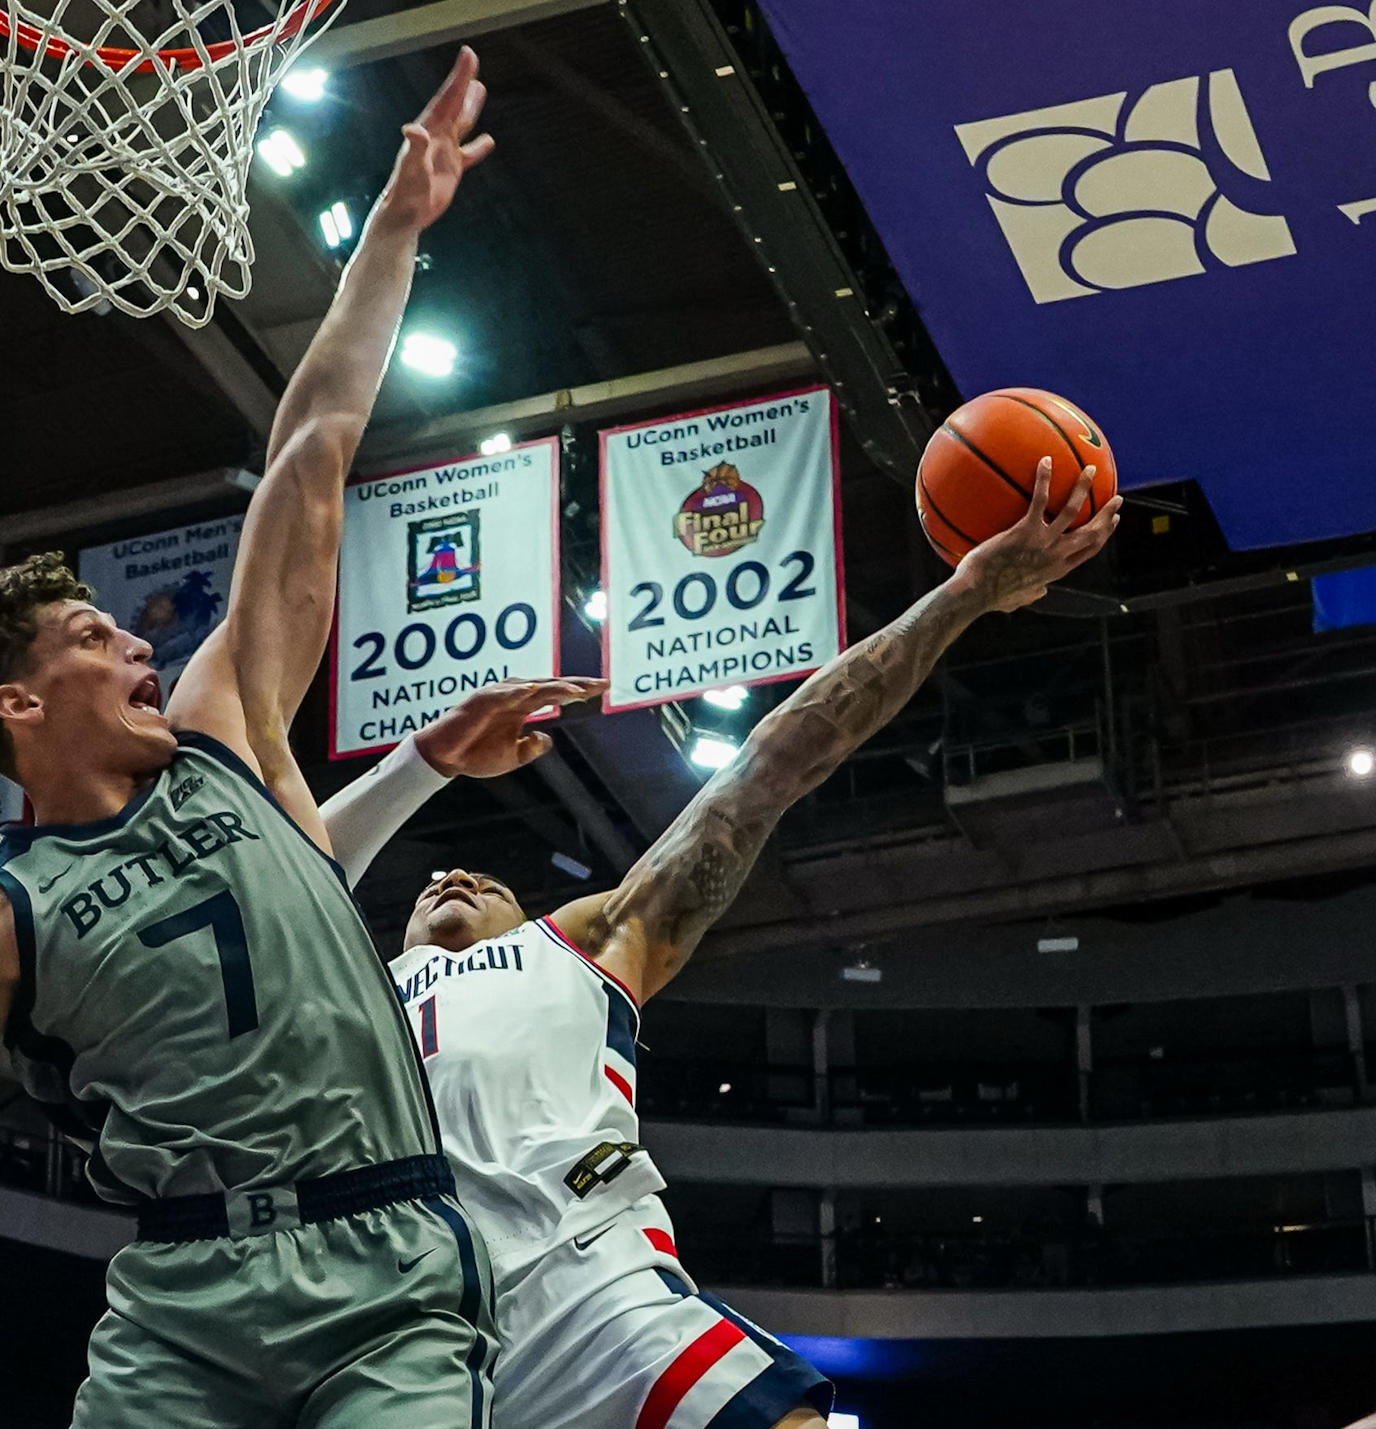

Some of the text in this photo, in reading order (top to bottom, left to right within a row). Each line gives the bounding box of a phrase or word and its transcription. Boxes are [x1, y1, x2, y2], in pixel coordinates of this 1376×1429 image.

[627, 400, 810, 450] UConn Women's
[660, 429, 776, 467] Basketball
[357, 454, 533, 502] UConn Women's
[389, 482, 499, 519] Basketball
[113, 535, 179, 560] UConn
[125, 543, 229, 580] Basketball
[627, 550, 817, 633] 2002
[350, 602, 537, 682] 2000
[646, 615, 801, 661] NATIONAL
[634, 642, 814, 694] CHAMPIONS
[60, 811, 261, 941] BUTLER
[136, 888, 260, 1040] 7
[396, 944, 525, 1004] NECTICUT
[247, 1192, 277, 1227] B
